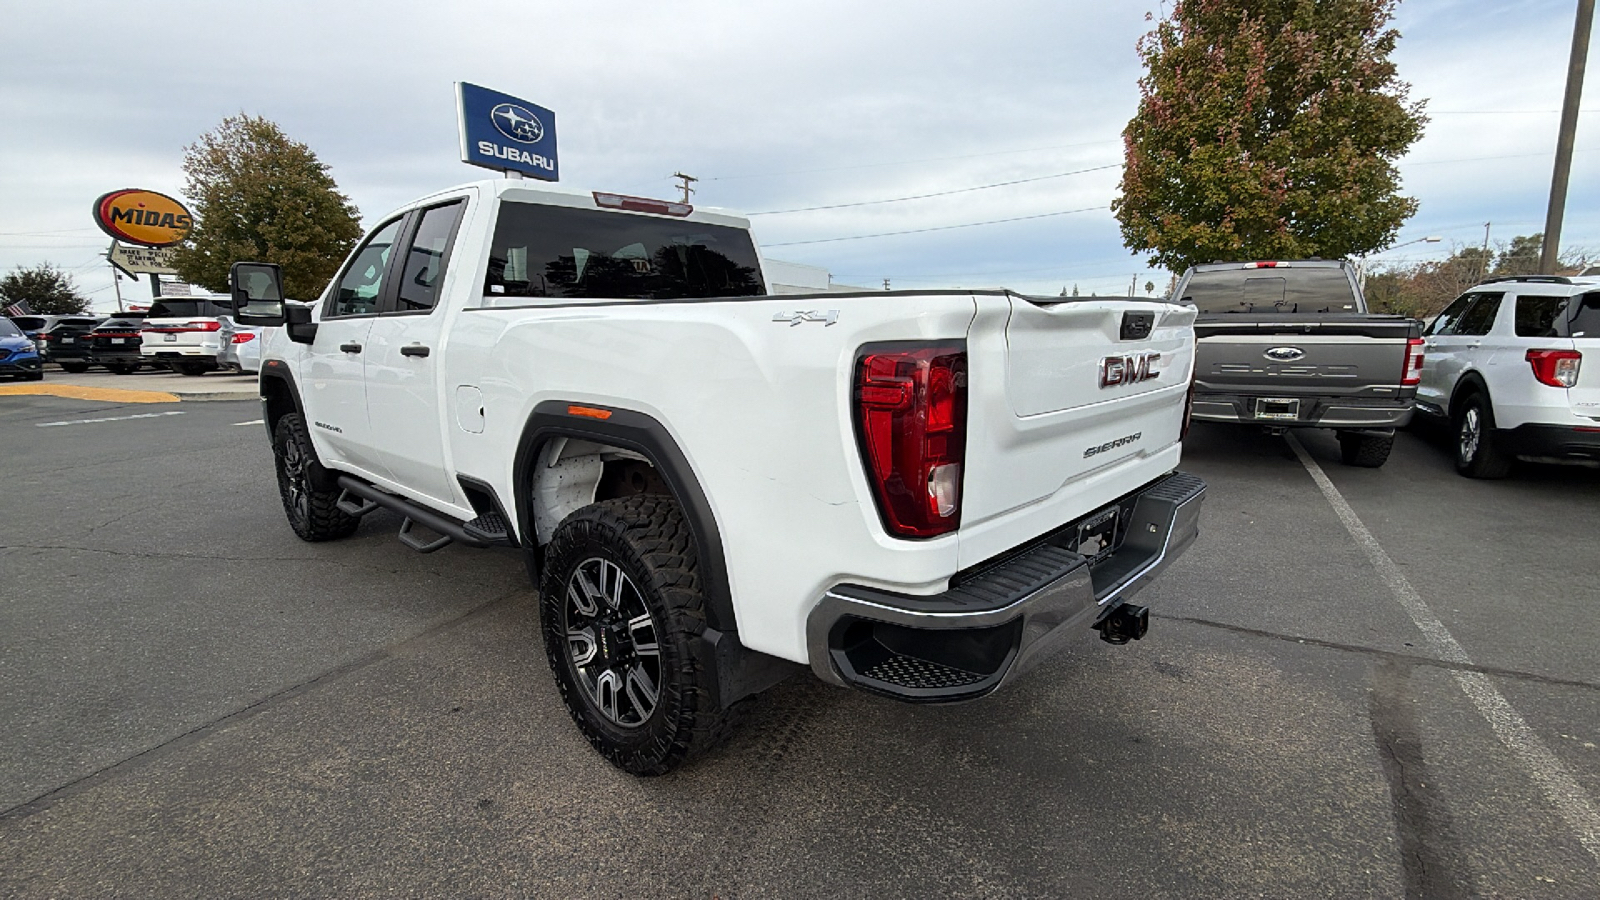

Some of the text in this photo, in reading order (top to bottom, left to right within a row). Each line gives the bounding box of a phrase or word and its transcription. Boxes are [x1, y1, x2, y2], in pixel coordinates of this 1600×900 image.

[478, 140, 554, 171] SUBARU
[110, 202, 191, 231] MIDAS
[1097, 352, 1161, 391] GMC
[1083, 431, 1142, 460] SIERRA
